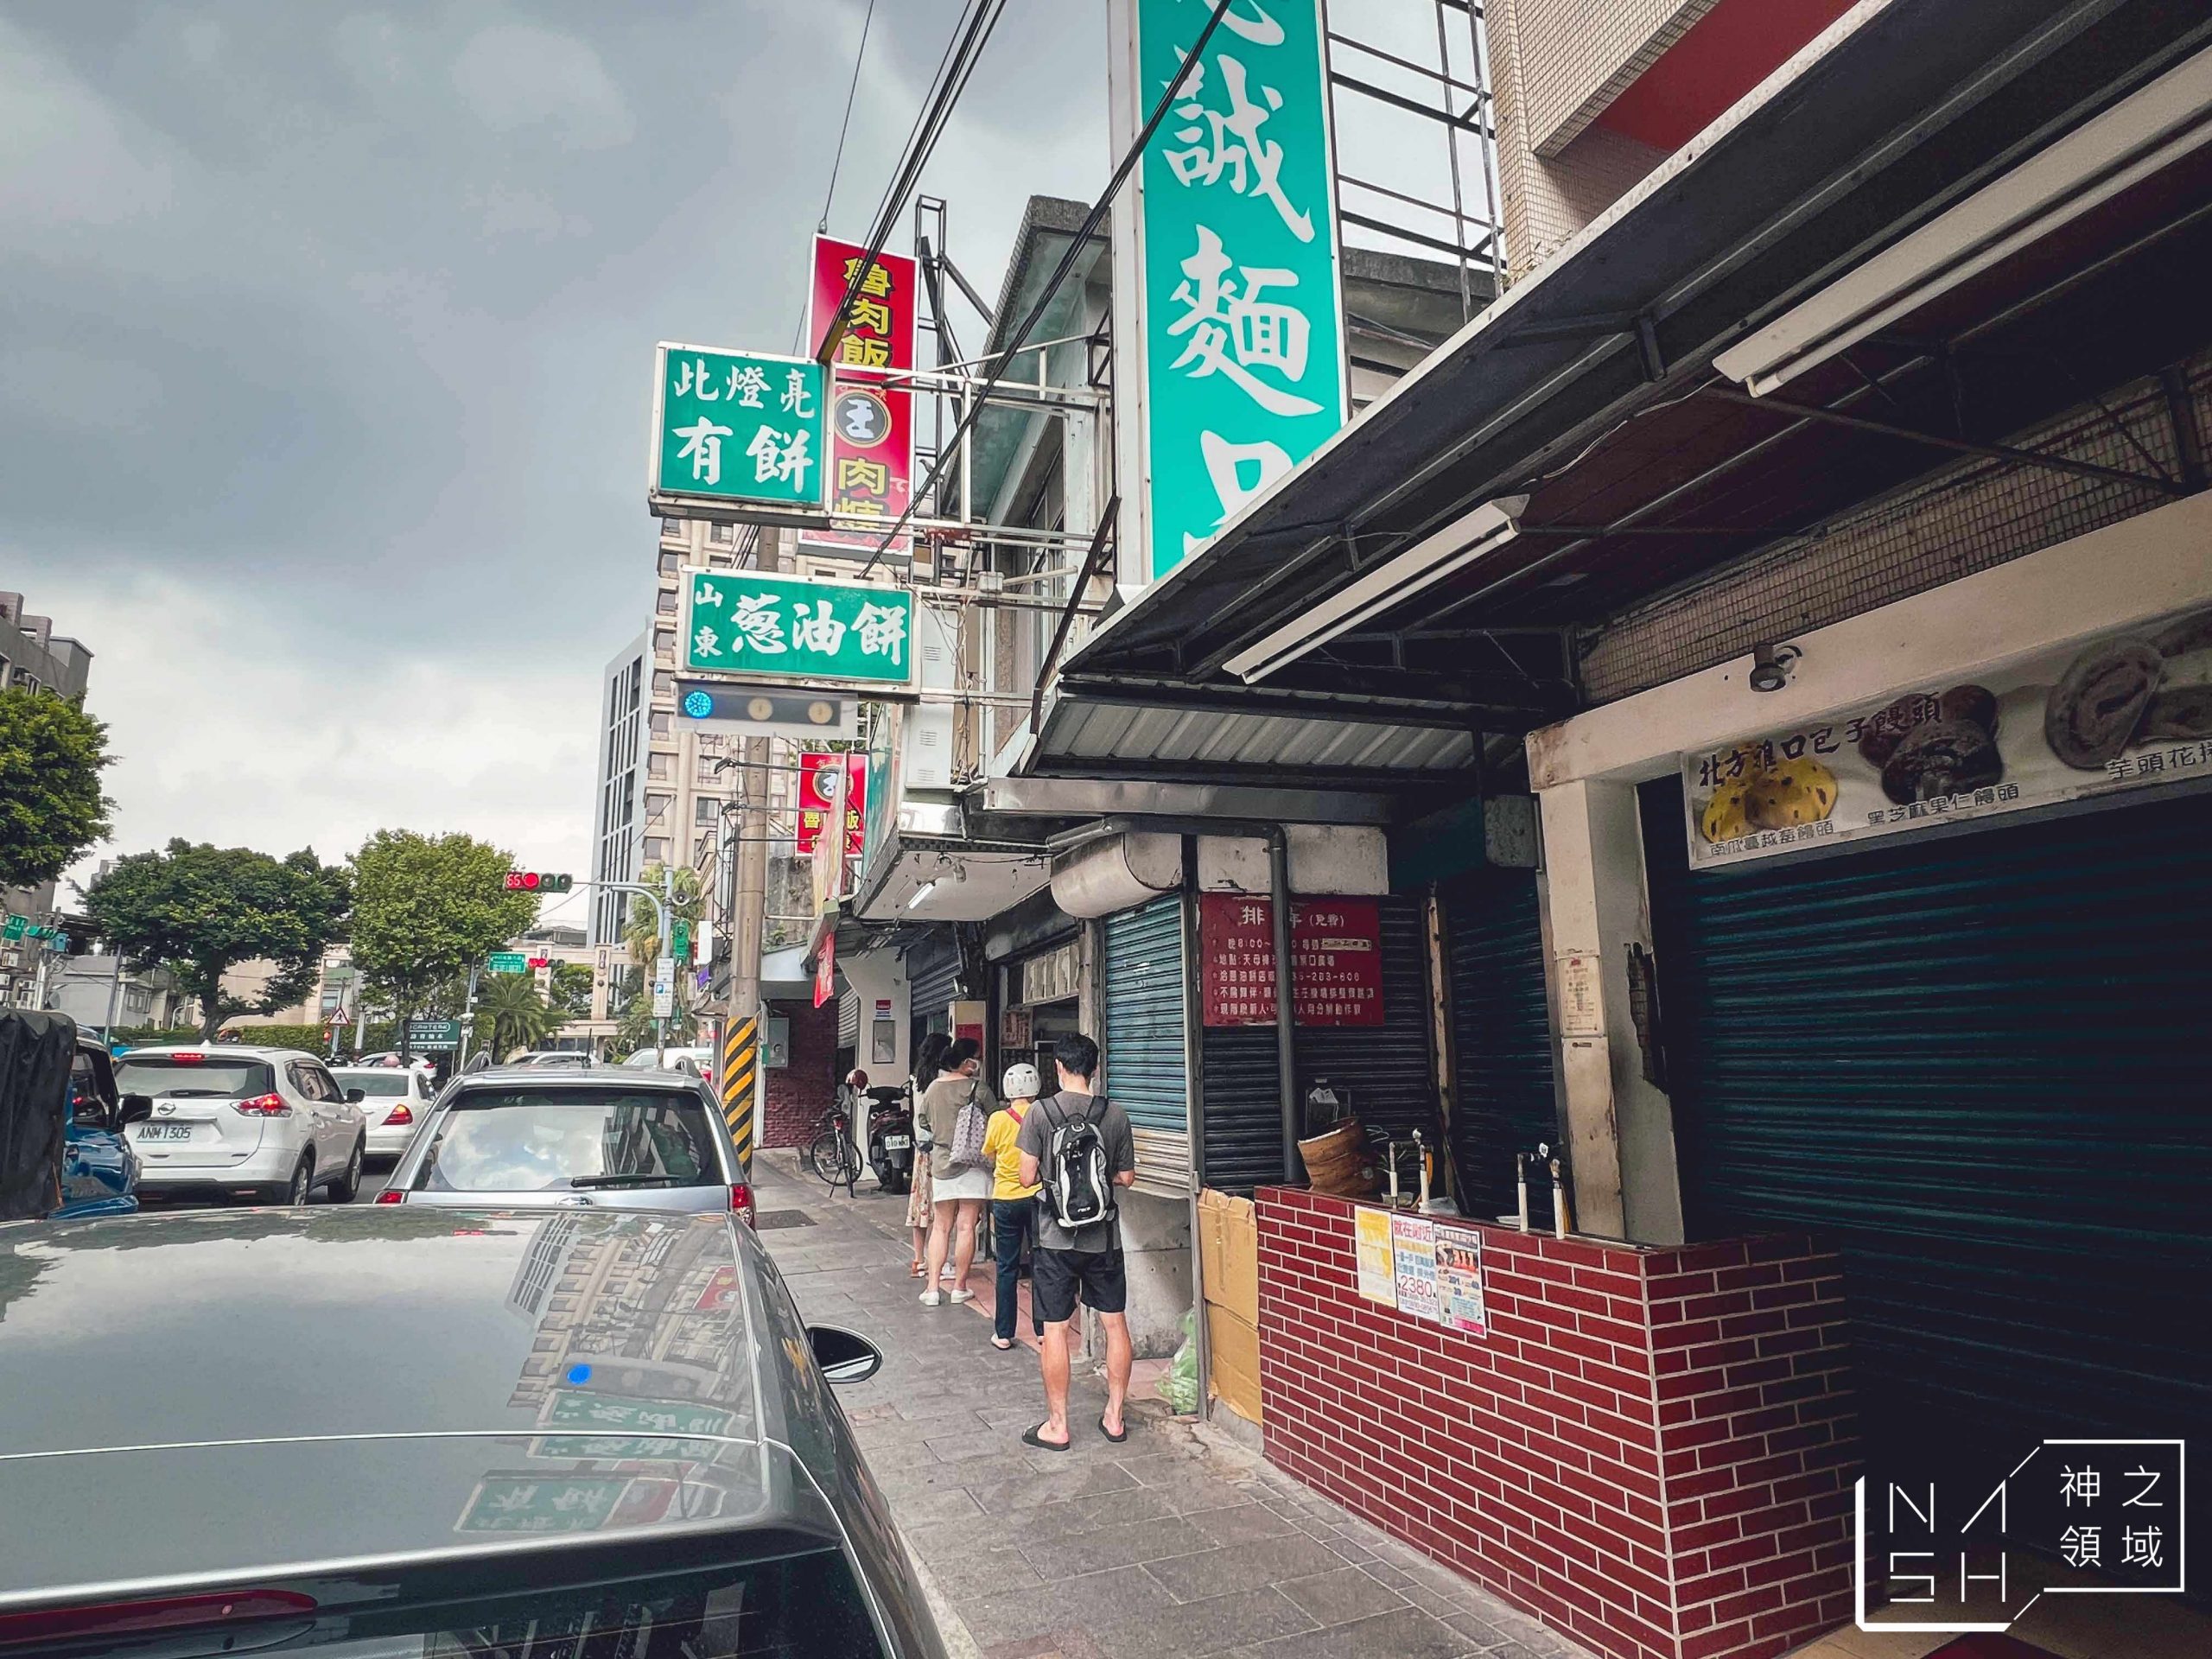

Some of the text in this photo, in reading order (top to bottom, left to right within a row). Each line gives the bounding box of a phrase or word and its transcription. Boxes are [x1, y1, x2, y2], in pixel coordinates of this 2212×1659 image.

[841, 257, 892, 366] 魯肉飯
[1154, 0, 1315, 556] 誠麵
[674, 360, 815, 418] 此燈亮
[672, 416, 814, 493] 有餅
[694, 582, 723, 658] 山東
[1401, 1275, 1432, 1297] 2380
